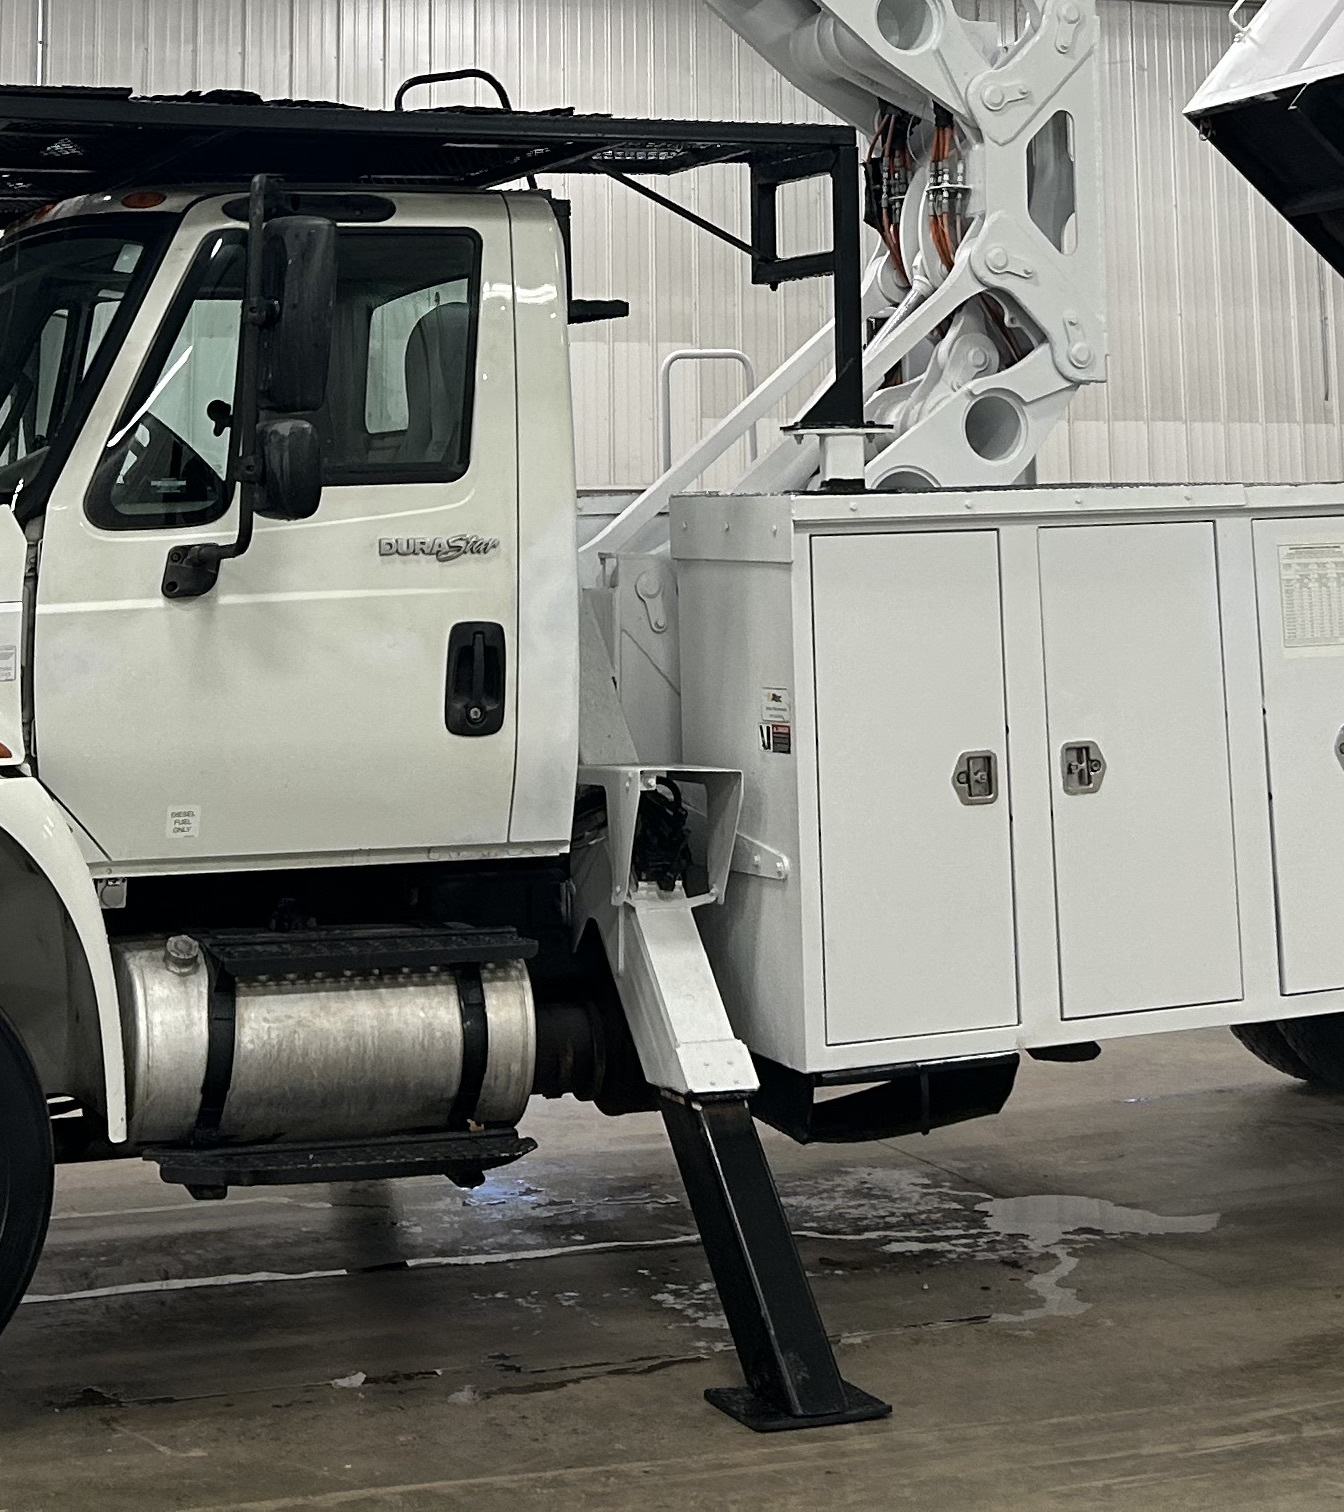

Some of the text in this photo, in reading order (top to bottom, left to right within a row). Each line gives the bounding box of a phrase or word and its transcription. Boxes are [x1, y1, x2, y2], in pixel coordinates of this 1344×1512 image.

[378, 534, 501, 562] DURAStar
[170, 810, 195, 818] DIESEL
[173, 818, 192, 826] FUEL
